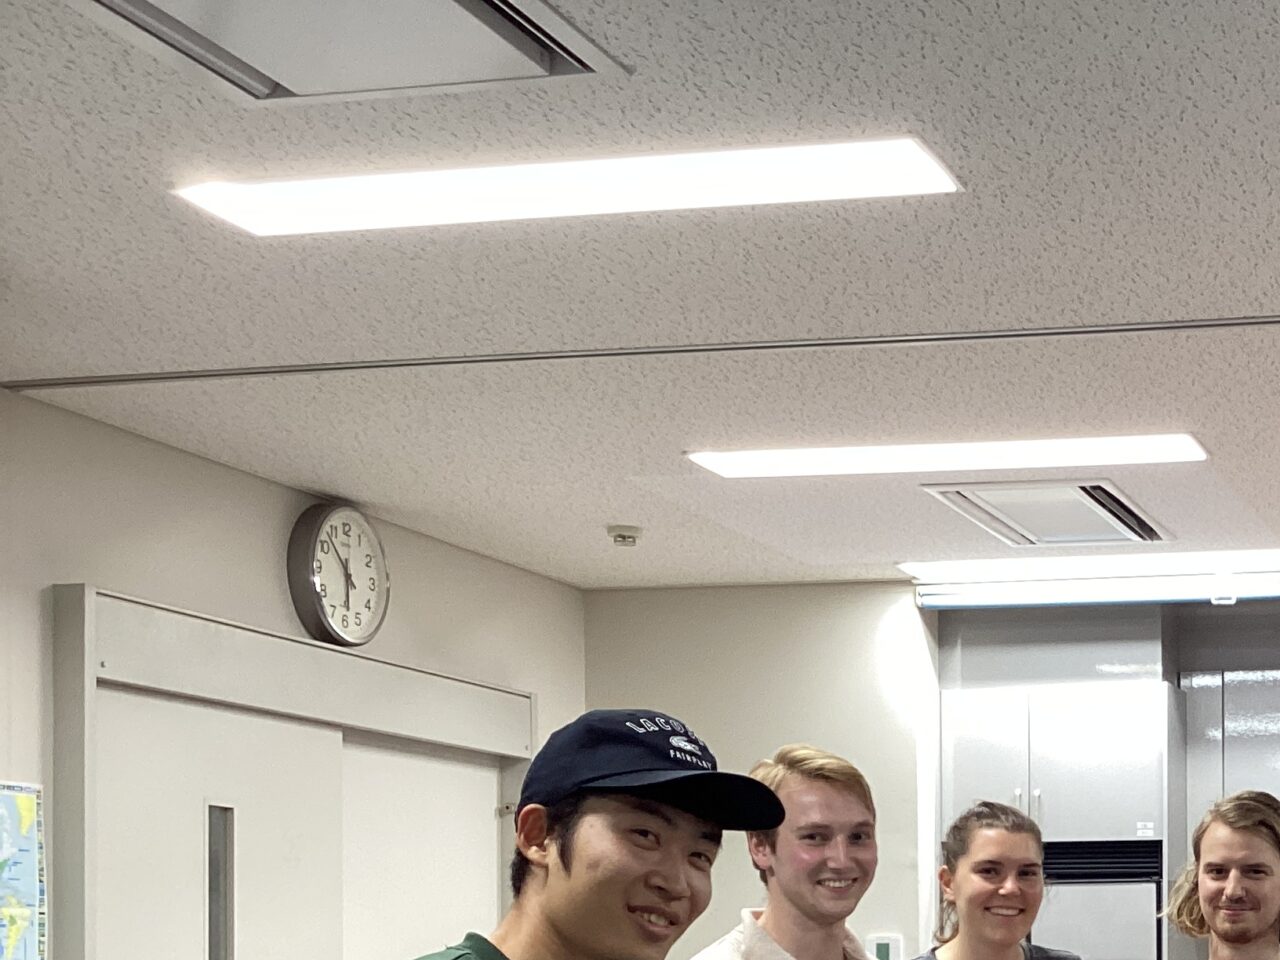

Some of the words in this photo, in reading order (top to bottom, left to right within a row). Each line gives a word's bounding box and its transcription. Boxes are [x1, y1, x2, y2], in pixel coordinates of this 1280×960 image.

[330, 525, 338, 539] 11
[342, 522, 352, 537] 12
[319, 540, 330, 555] 10
[314, 559, 322, 574] 9
[365, 554, 373, 568] 2
[319, 584, 328, 598] 8
[368, 577, 376, 592] 3
[329, 604, 337, 618] 7
[364, 598, 372, 612] 4
[341, 614, 349, 629] 6
[354, 612, 362, 626] 5
[669, 749, 712, 770] FAIRPLAY
